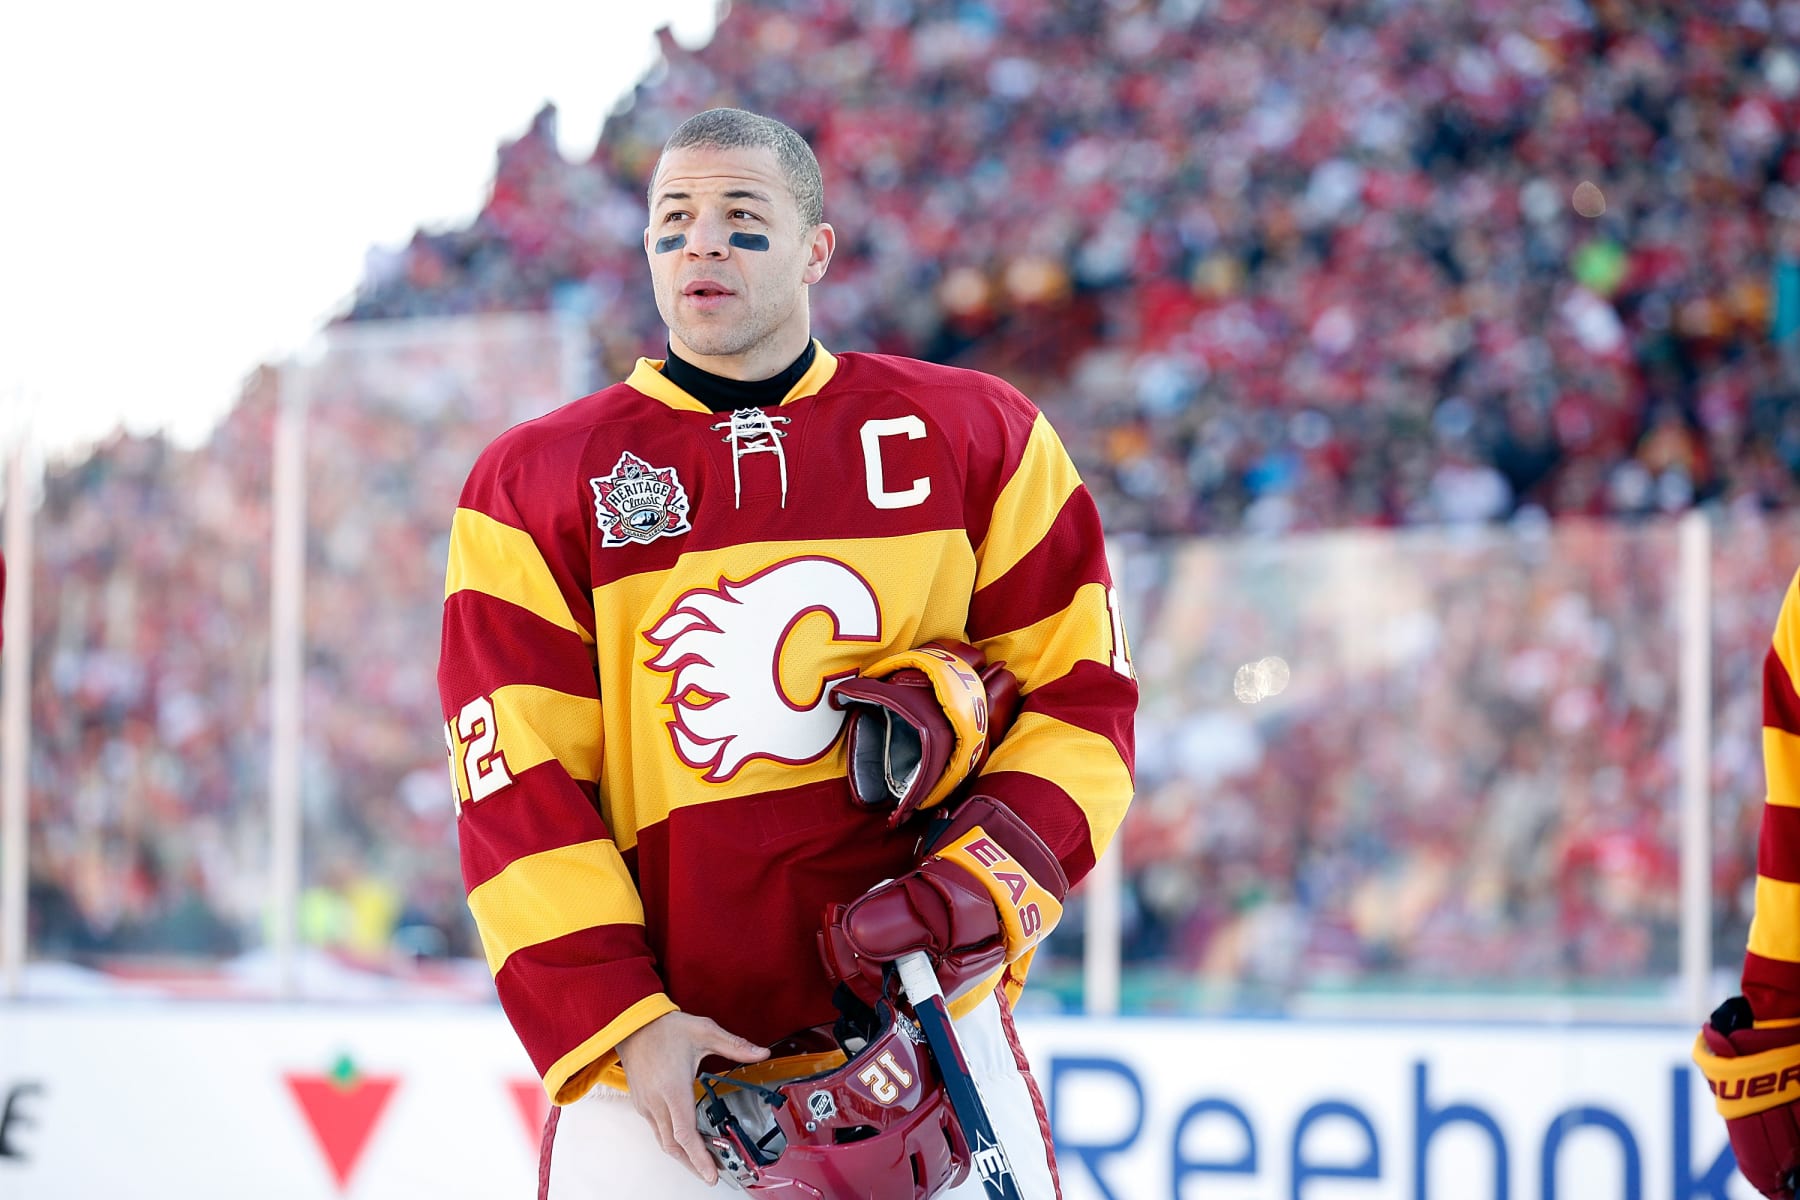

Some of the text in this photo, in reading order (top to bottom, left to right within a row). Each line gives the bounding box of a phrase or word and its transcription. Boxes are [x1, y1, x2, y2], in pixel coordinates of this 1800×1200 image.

[860, 415, 931, 509] C
[608, 481, 671, 507] HERITAGE
[622, 494, 662, 513] Classic
[961, 836, 1042, 940] EAS
[857, 1049, 913, 1105] 12
